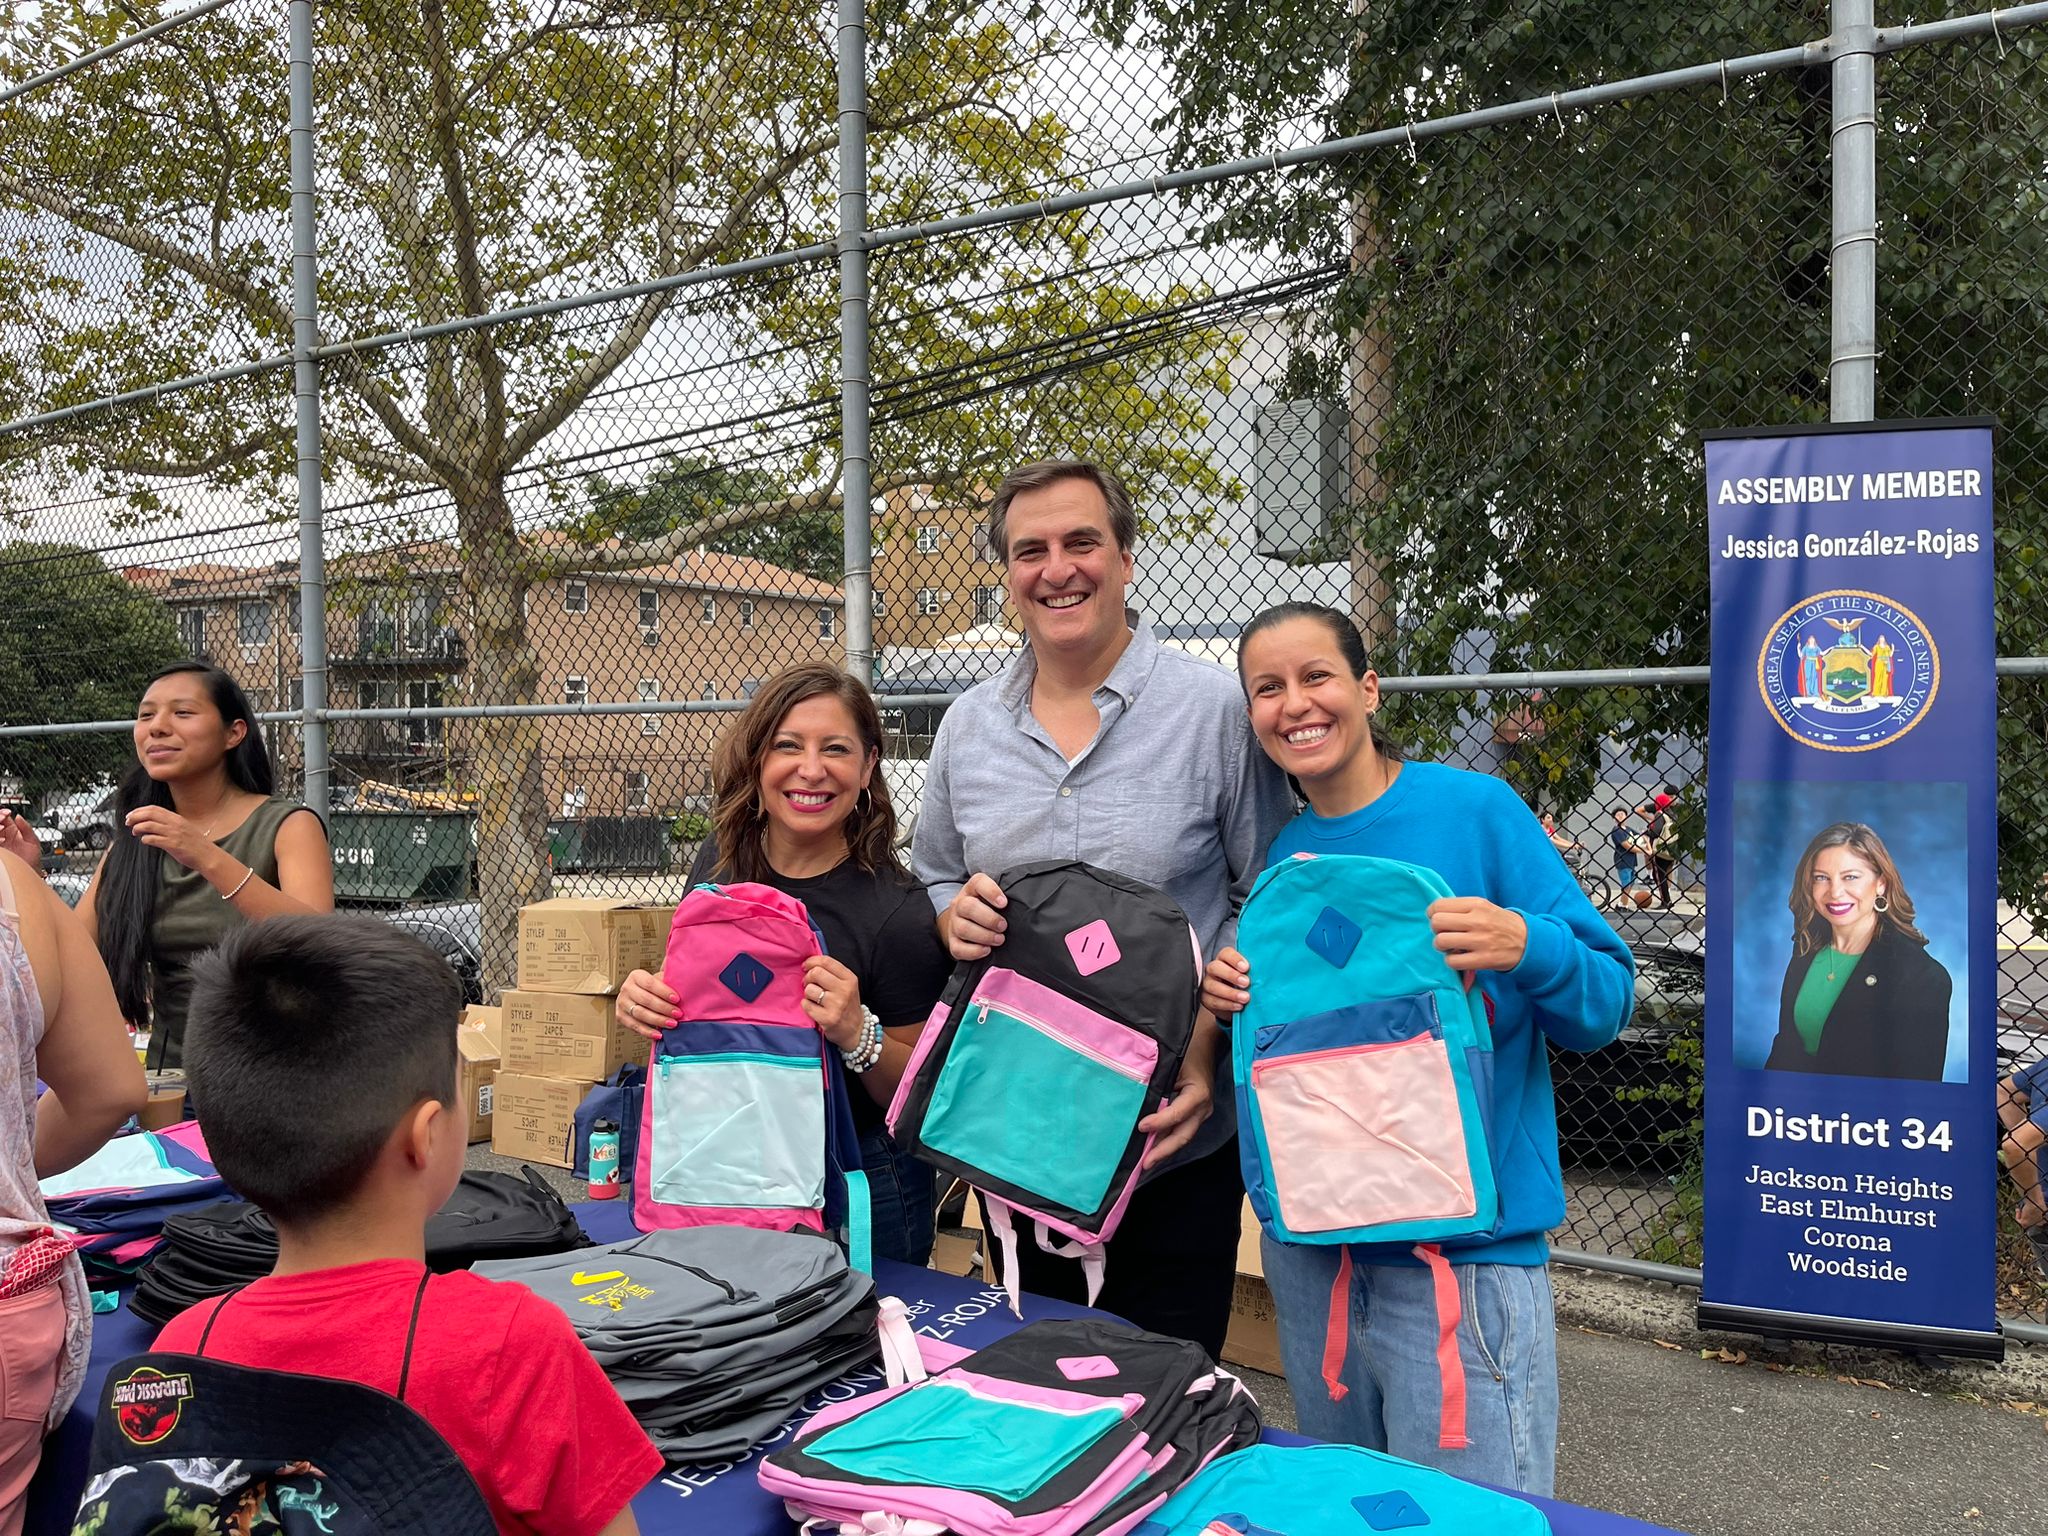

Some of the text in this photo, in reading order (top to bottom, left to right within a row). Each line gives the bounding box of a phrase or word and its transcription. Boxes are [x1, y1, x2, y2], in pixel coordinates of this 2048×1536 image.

[1717, 469, 1982, 505] ASSEMBLY MEMBER
[1721, 527, 1980, 560] Jessica González-Rojas
[1767, 597, 1930, 725] THE GREAT SEAL OF THE STATE OF NEW YORK
[511, 1009, 533, 1020] STYLE#
[544, 1025, 564, 1036] 24PCS
[1747, 1106, 1953, 1152] District 34
[1745, 1165, 1954, 1202] Jackson Heights
[1760, 1193, 1937, 1228] East Elmhurst
[1804, 1227, 1891, 1252] Corona
[1788, 1252, 1908, 1282] Woodside
[114, 1376, 189, 1403] JURASSIC PARK
